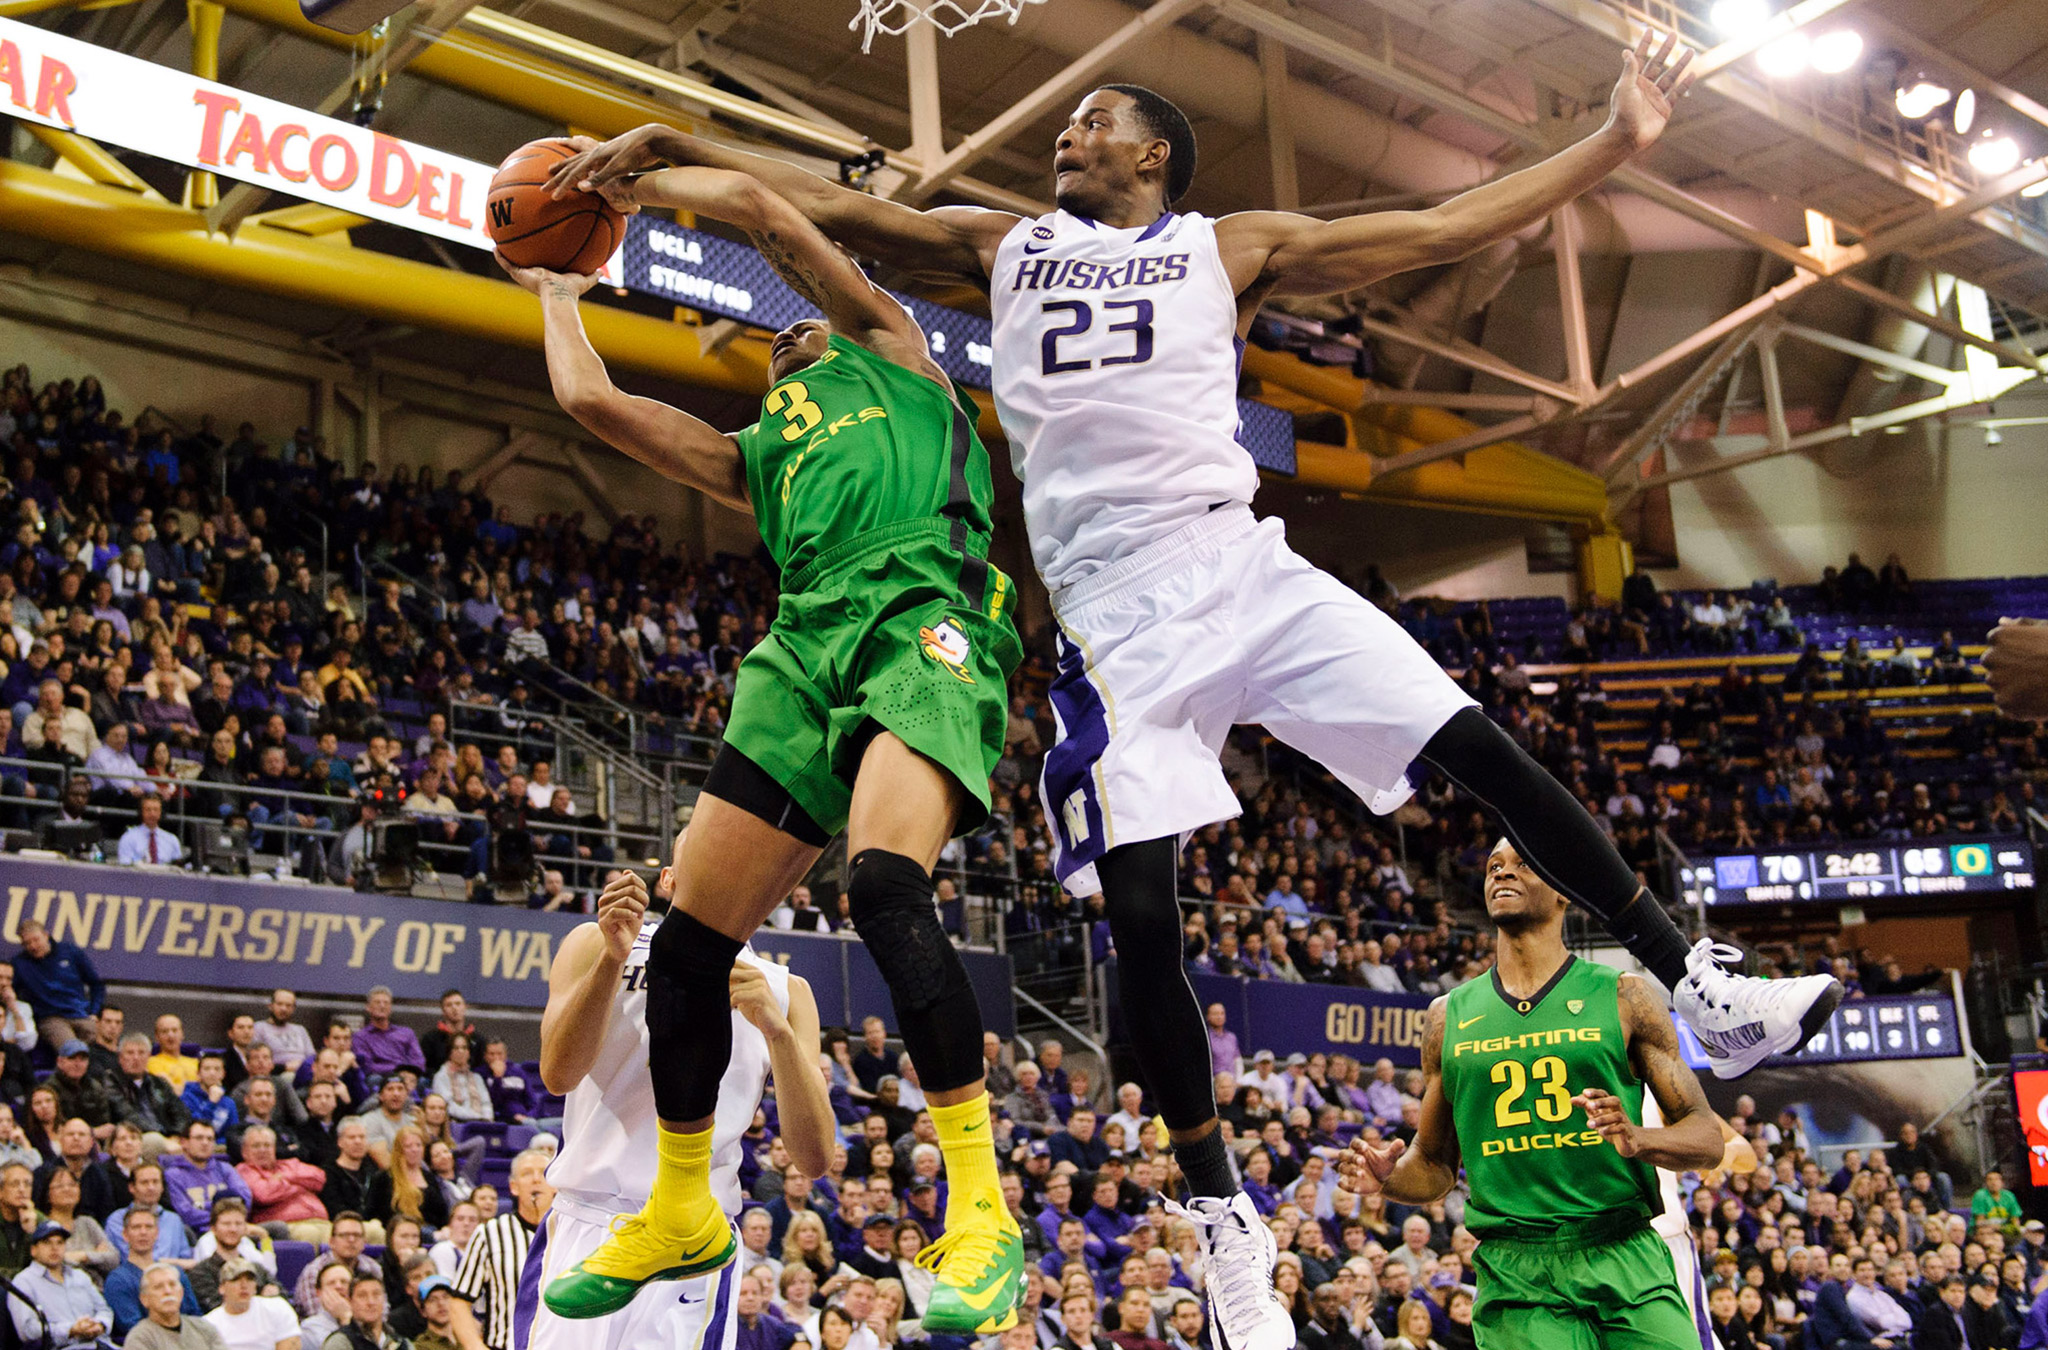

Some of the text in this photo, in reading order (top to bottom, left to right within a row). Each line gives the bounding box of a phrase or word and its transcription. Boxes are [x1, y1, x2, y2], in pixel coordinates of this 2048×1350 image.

[192, 88, 359, 192] TACO
[490, 197, 514, 228] W
[648, 229, 703, 265] UCLA
[649, 264, 753, 312] STANFORD
[1012, 252, 1191, 292] HUSKIES
[1041, 298, 1154, 377] 23
[765, 381, 824, 442] 3
[781, 406, 887, 507] DUCKS
[1762, 854, 1801, 884] 70
[1825, 854, 1882, 877] 2:42
[1903, 848, 1943, 875] 65
[1956, 847, 1987, 874] O
[3, 886, 385, 969] UNIVERSITY
[392, 921, 466, 974] OF
[1325, 1002, 1366, 1044] GO
[1517, 1001, 1531, 1012] O
[1454, 1028, 1601, 1057] FIGHTING
[1887, 1029, 1903, 1048] 3
[1490, 1055, 1573, 1128] 23
[1482, 1131, 1603, 1156] DUCKS
